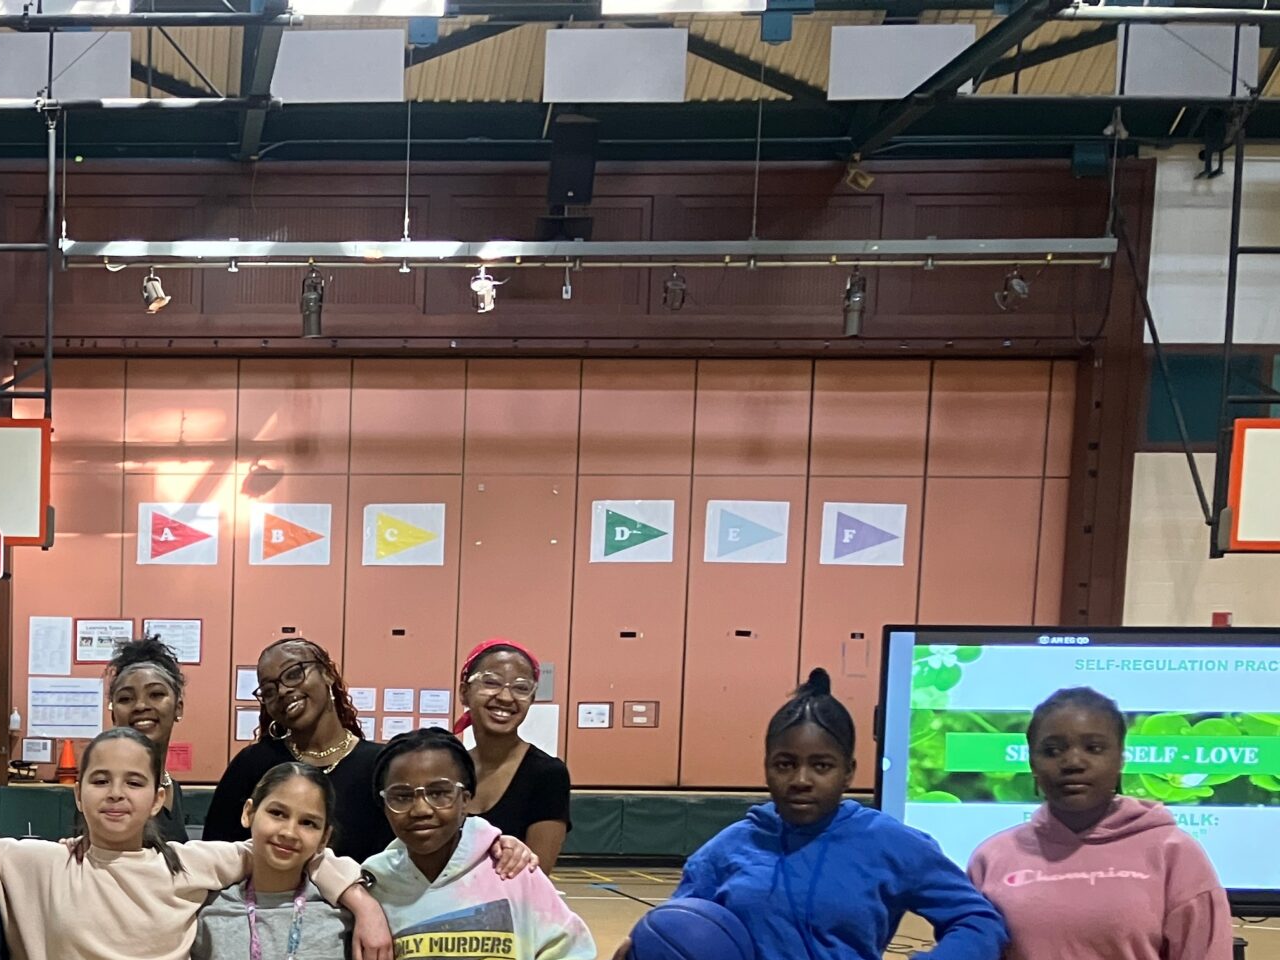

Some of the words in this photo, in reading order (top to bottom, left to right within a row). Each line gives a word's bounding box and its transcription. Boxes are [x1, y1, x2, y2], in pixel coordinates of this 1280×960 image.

[159, 527, 174, 541] A
[271, 529, 285, 543] B
[384, 528, 399, 542] C
[614, 527, 629, 541] D
[728, 528, 740, 541] E
[843, 529, 856, 543] F
[1074, 659, 1228, 671] SELF-REGULATION
[1234, 660, 1280, 672] PRAC
[1123, 746, 1178, 763] SELF
[1195, 747, 1259, 764] LOVE
[1004, 866, 1150, 887] Champion
[429, 936, 513, 954] MURDERS
